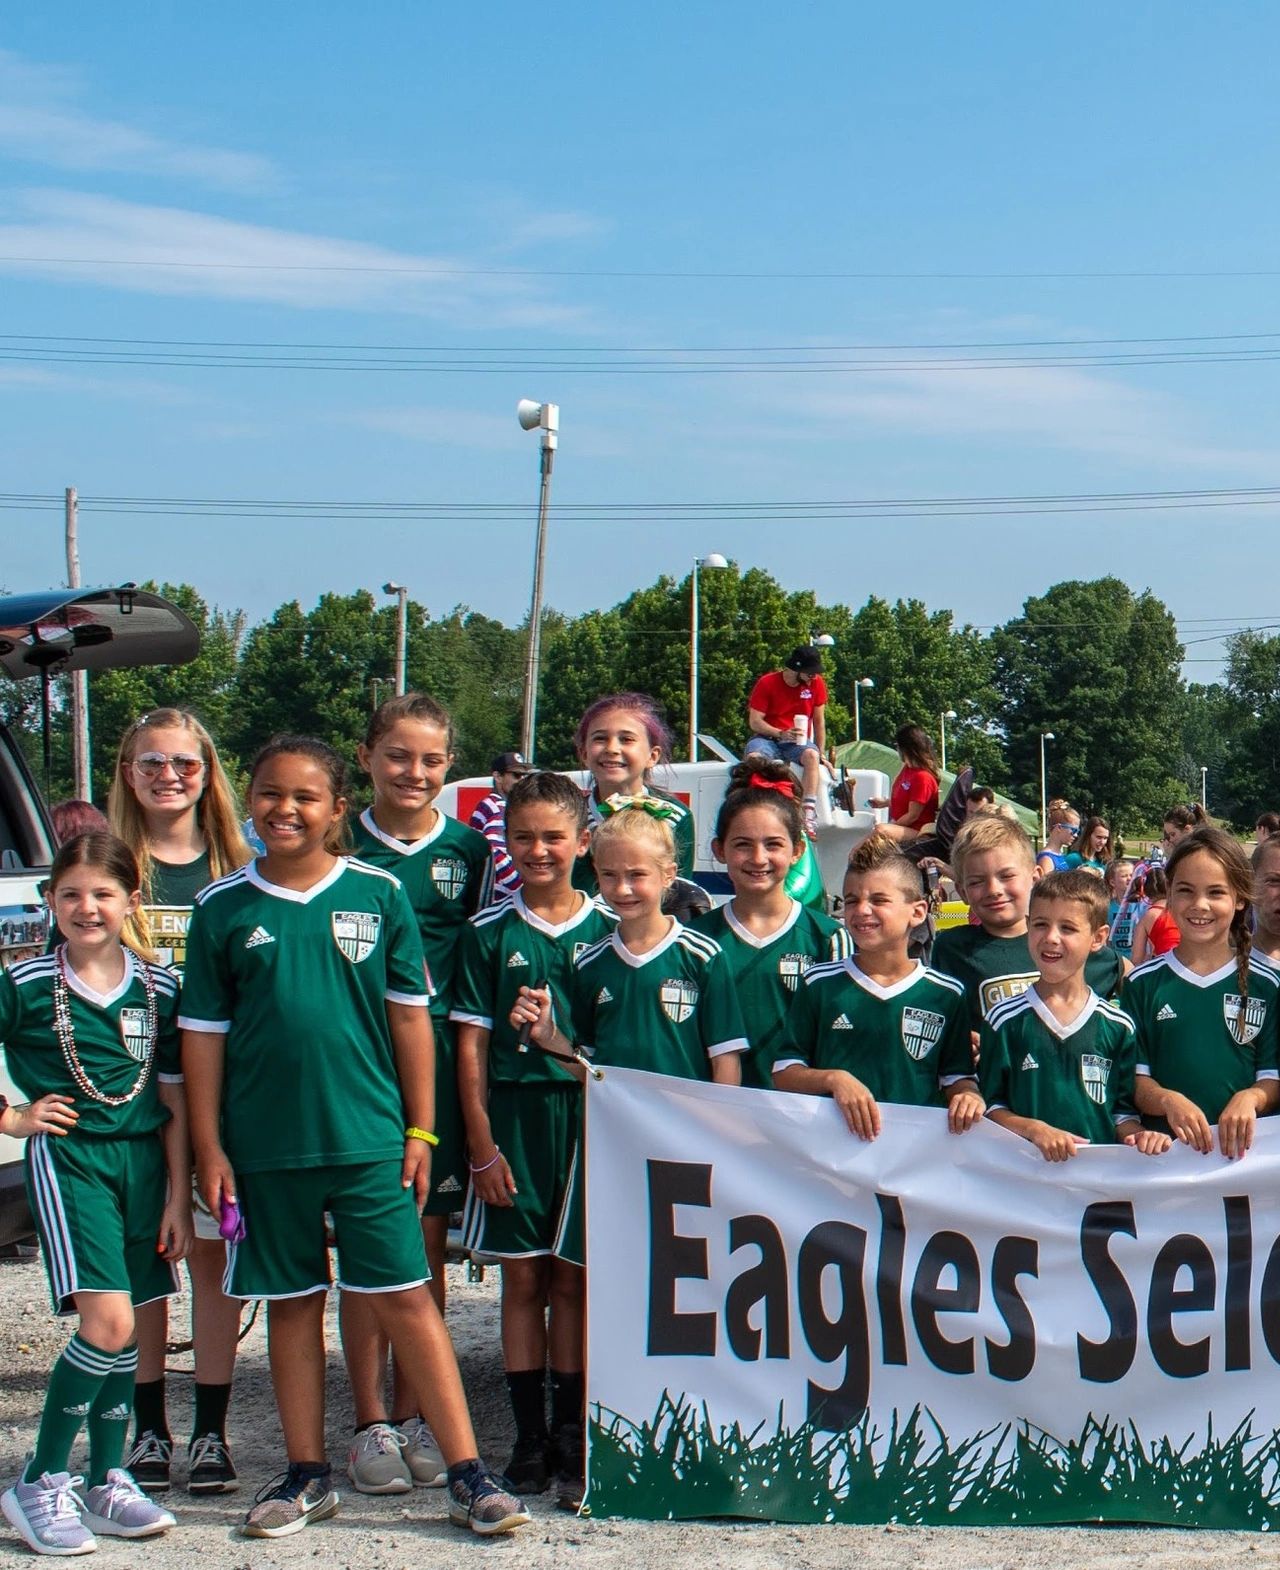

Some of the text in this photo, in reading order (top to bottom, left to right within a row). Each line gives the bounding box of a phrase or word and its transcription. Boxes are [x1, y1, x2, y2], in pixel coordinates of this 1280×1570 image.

[149, 915, 192, 934] LEN
[245, 937, 276, 949] adidas
[1156, 1013, 1177, 1021] adidas
[646, 1158, 1039, 1432] Eagles
